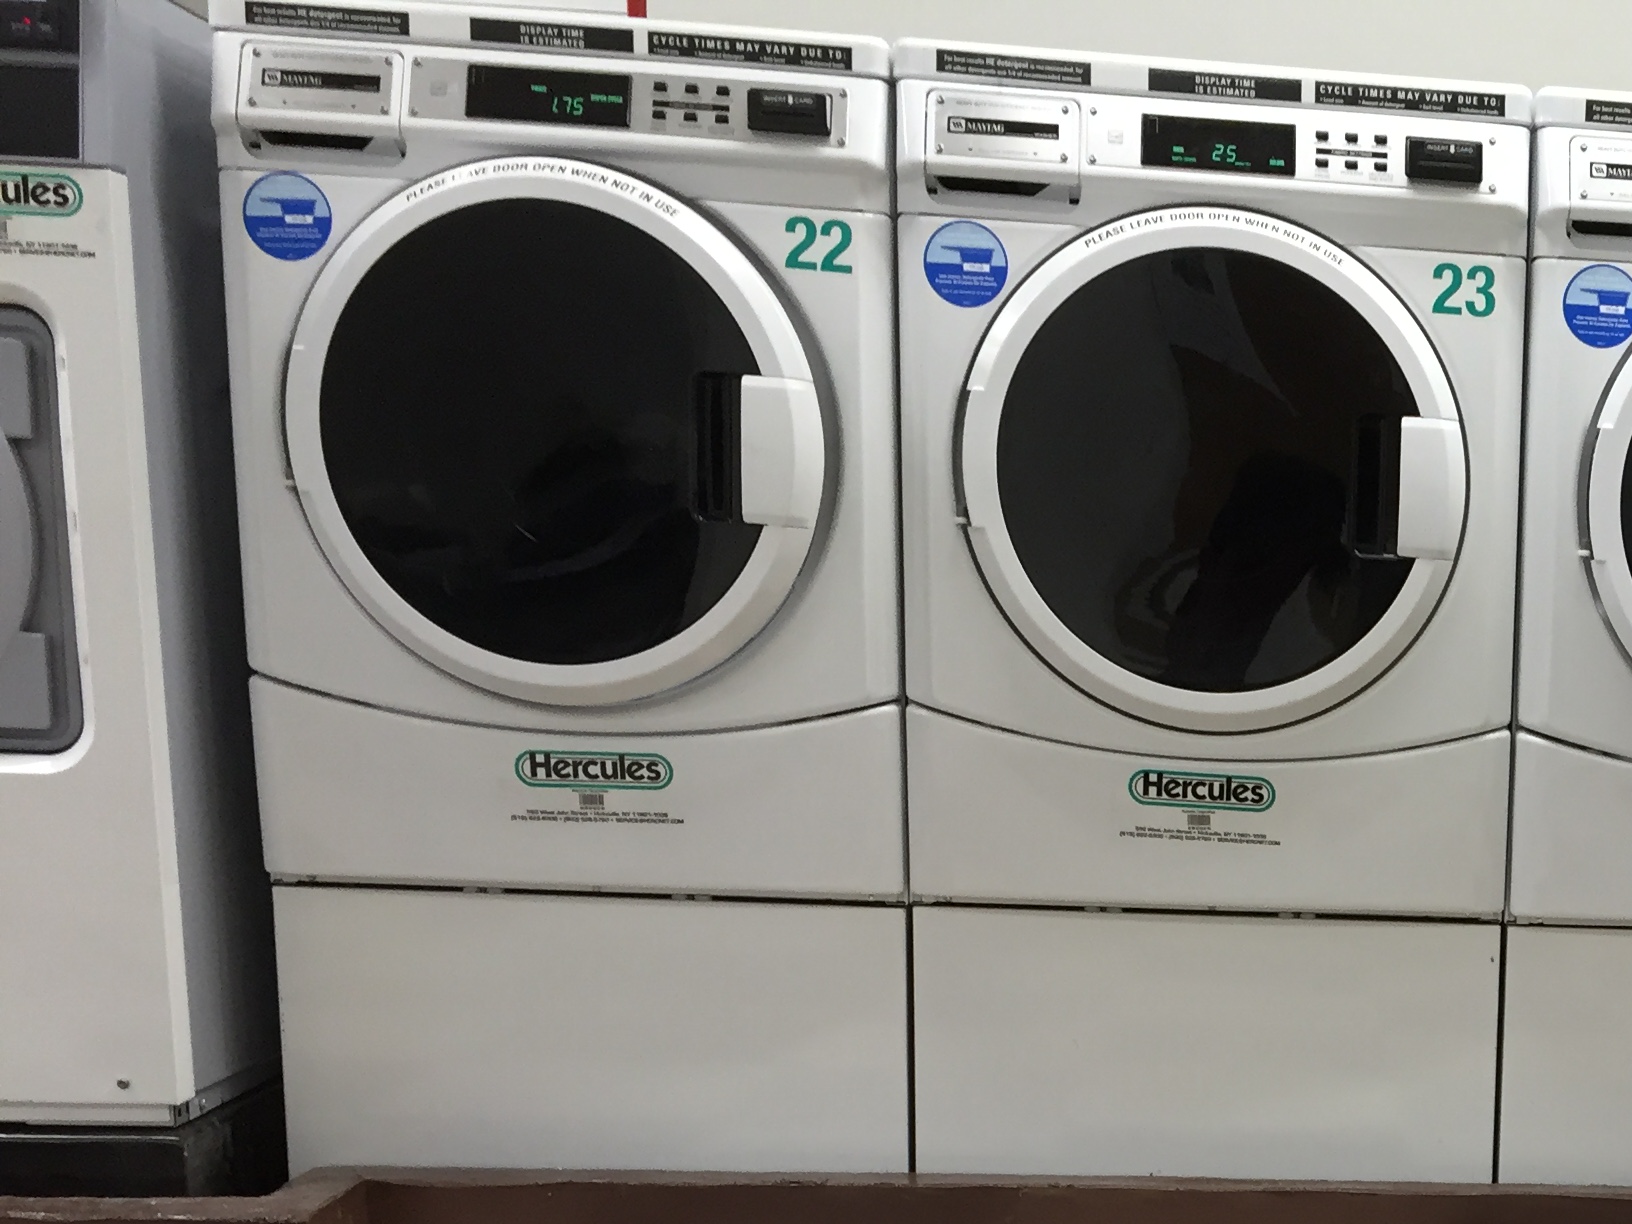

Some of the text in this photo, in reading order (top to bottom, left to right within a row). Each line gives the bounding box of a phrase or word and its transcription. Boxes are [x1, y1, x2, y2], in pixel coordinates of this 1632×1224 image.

[520, 24, 584, 38] DISPLAY TIME
[520, 36, 584, 48] IS ESTIMATED
[653, 35, 688, 48] CYCLE
[694, 38, 730, 50] TIMES
[736, 42, 760, 52] MAY
[765, 44, 794, 56] VARY
[800, 46, 822, 58] DUE
[282, 74, 322, 85] MAYTAG
[1195, 75, 1255, 88] DISPLAY TIME
[1195, 86, 1256, 98] IS ESTIMATED
[1320, 84, 1352, 96] CYCLE
[1358, 88, 1392, 98] TIMES
[1398, 90, 1420, 100] MAY
[1425, 92, 1452, 103] VARY
[1458, 94, 1478, 105] DUE
[966, 121, 1004, 133] MAYTAG
[1212, 144, 1237, 162] 25
[406, 177, 446, 202] PLEASE
[493, 163, 528, 175] DOOR
[533, 163, 566, 174] OPEN
[571, 168, 608, 183] WHEN
[611, 180, 637, 195] NOT
[639, 190, 653, 202] IN
[655, 200, 680, 218] USE
[784, 216, 852, 273] 22
[1084, 212, 1344, 266] PLEASE LEAVE DOOR OPEN WHEN NOT IN USE
[1432, 263, 1496, 317] 23
[529, 750, 661, 781] Hercules
[1143, 772, 1264, 804] Hercules
